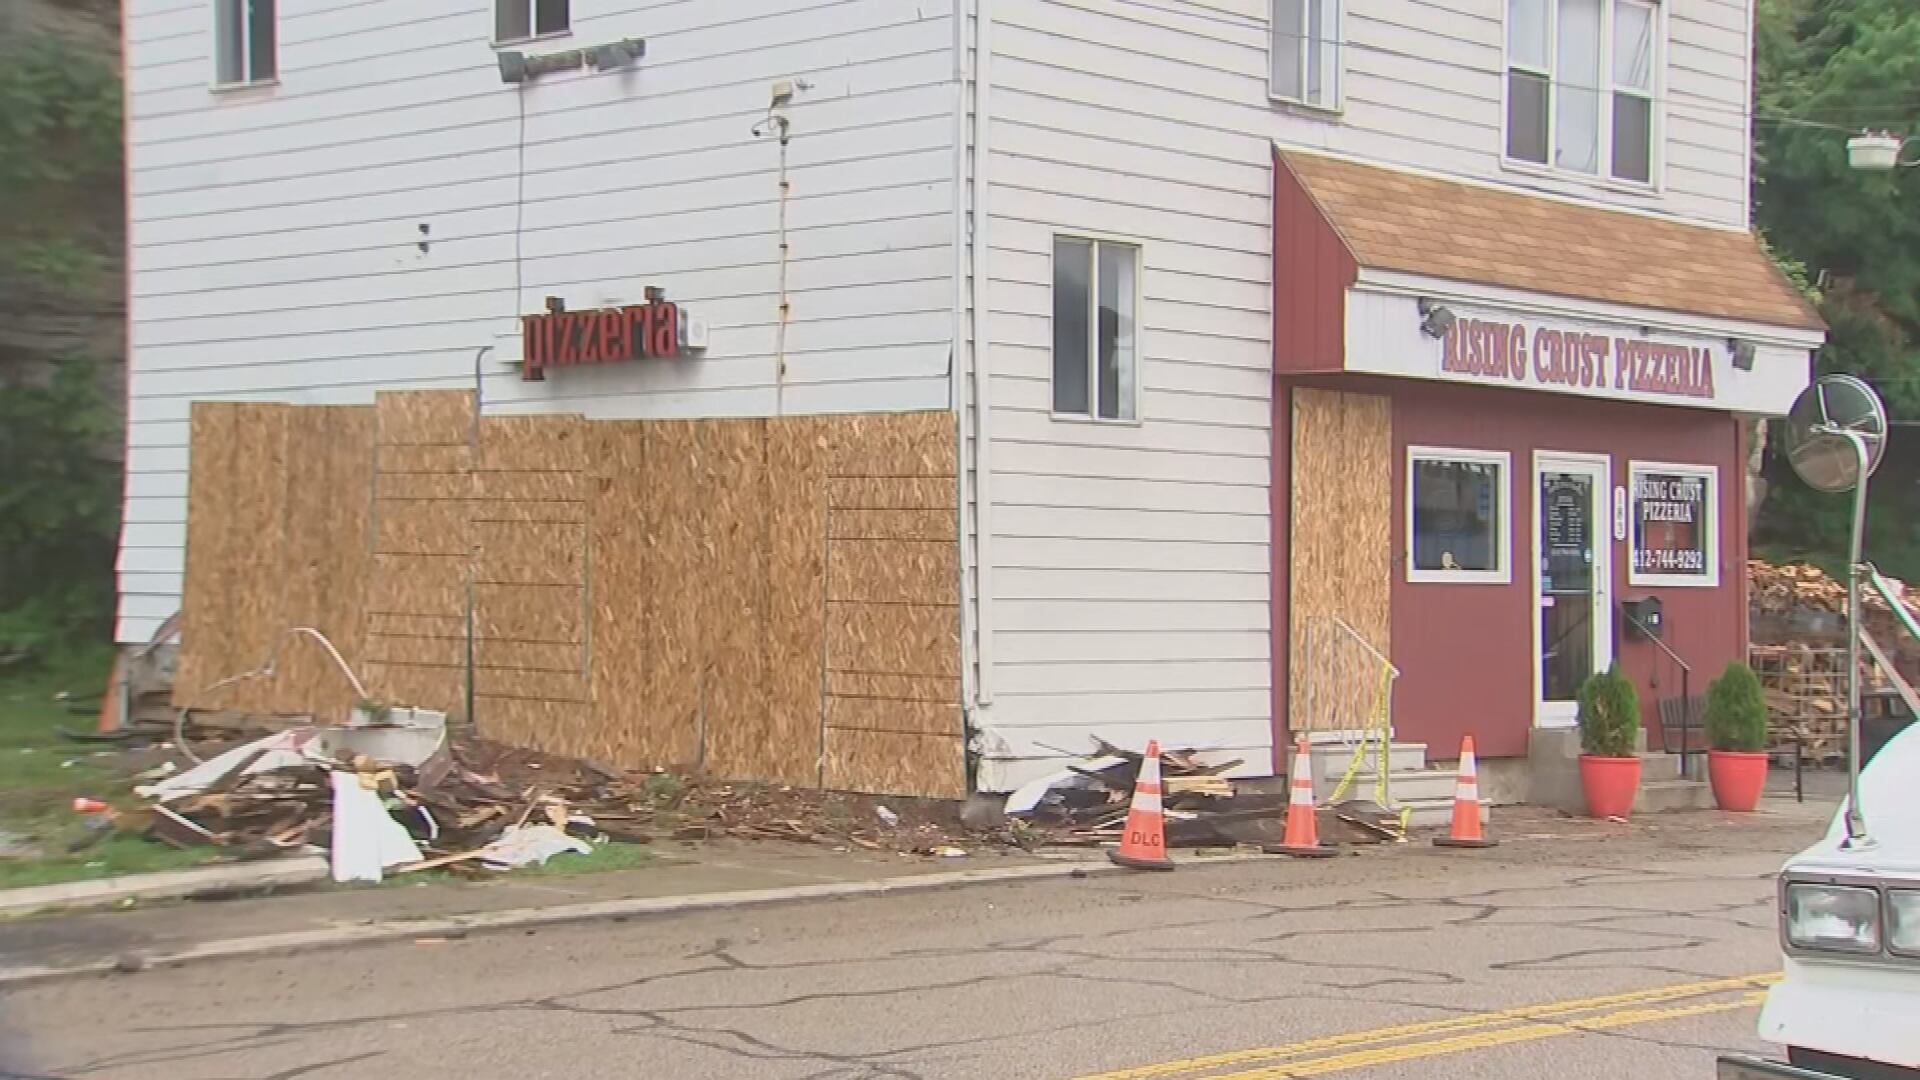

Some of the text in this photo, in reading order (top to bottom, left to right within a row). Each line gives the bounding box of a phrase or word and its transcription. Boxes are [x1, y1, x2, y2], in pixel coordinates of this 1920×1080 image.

[522, 301, 678, 381] pizzeria
[1443, 317, 1714, 398] RISING CRUST PIZZERIA
[1643, 501, 1692, 522] PIZZERIA
[1669, 482, 1702, 501] CRUST
